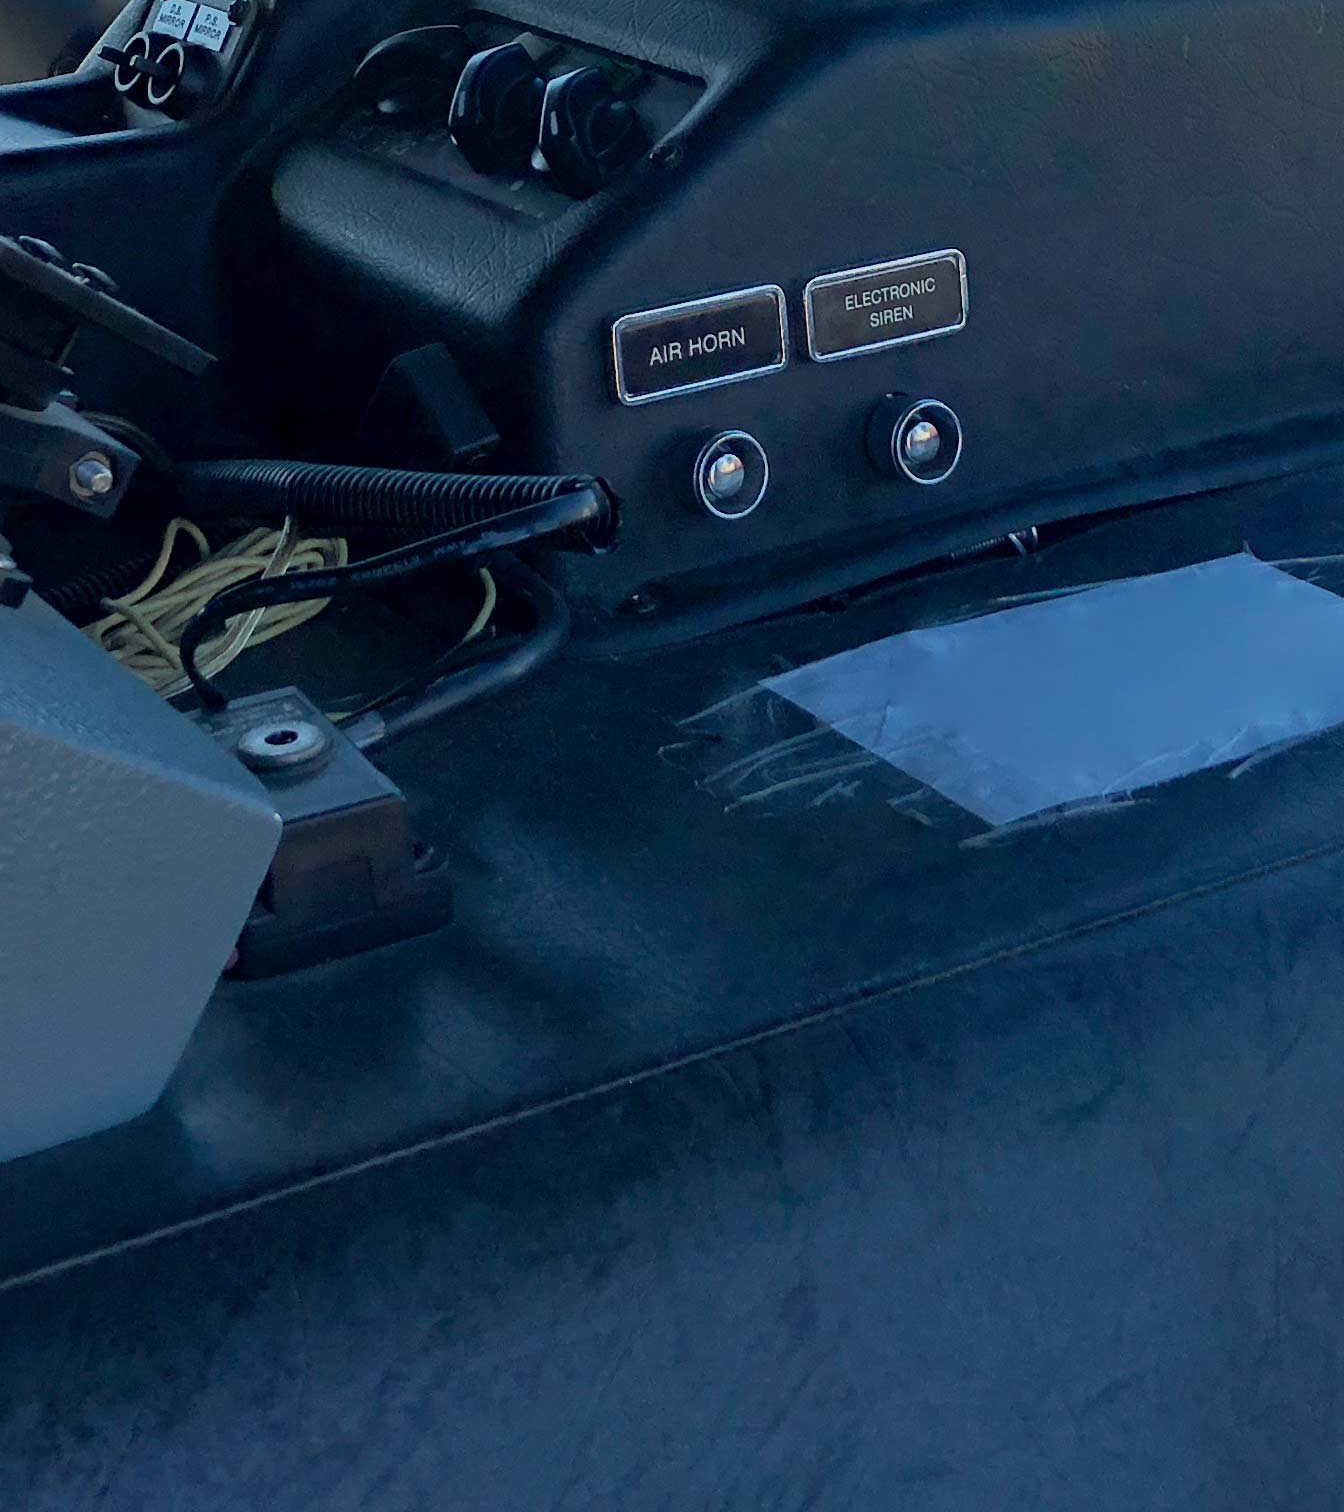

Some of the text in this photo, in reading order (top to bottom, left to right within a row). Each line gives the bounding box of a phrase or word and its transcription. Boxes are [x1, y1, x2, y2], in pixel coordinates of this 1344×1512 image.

[159, 13, 186, 29] MIRROR
[194, 24, 222, 41] MIRROR
[844, 277, 936, 311] ELECTRONIC
[870, 305, 914, 328] SIREN
[649, 326, 746, 367] AIR HORN
